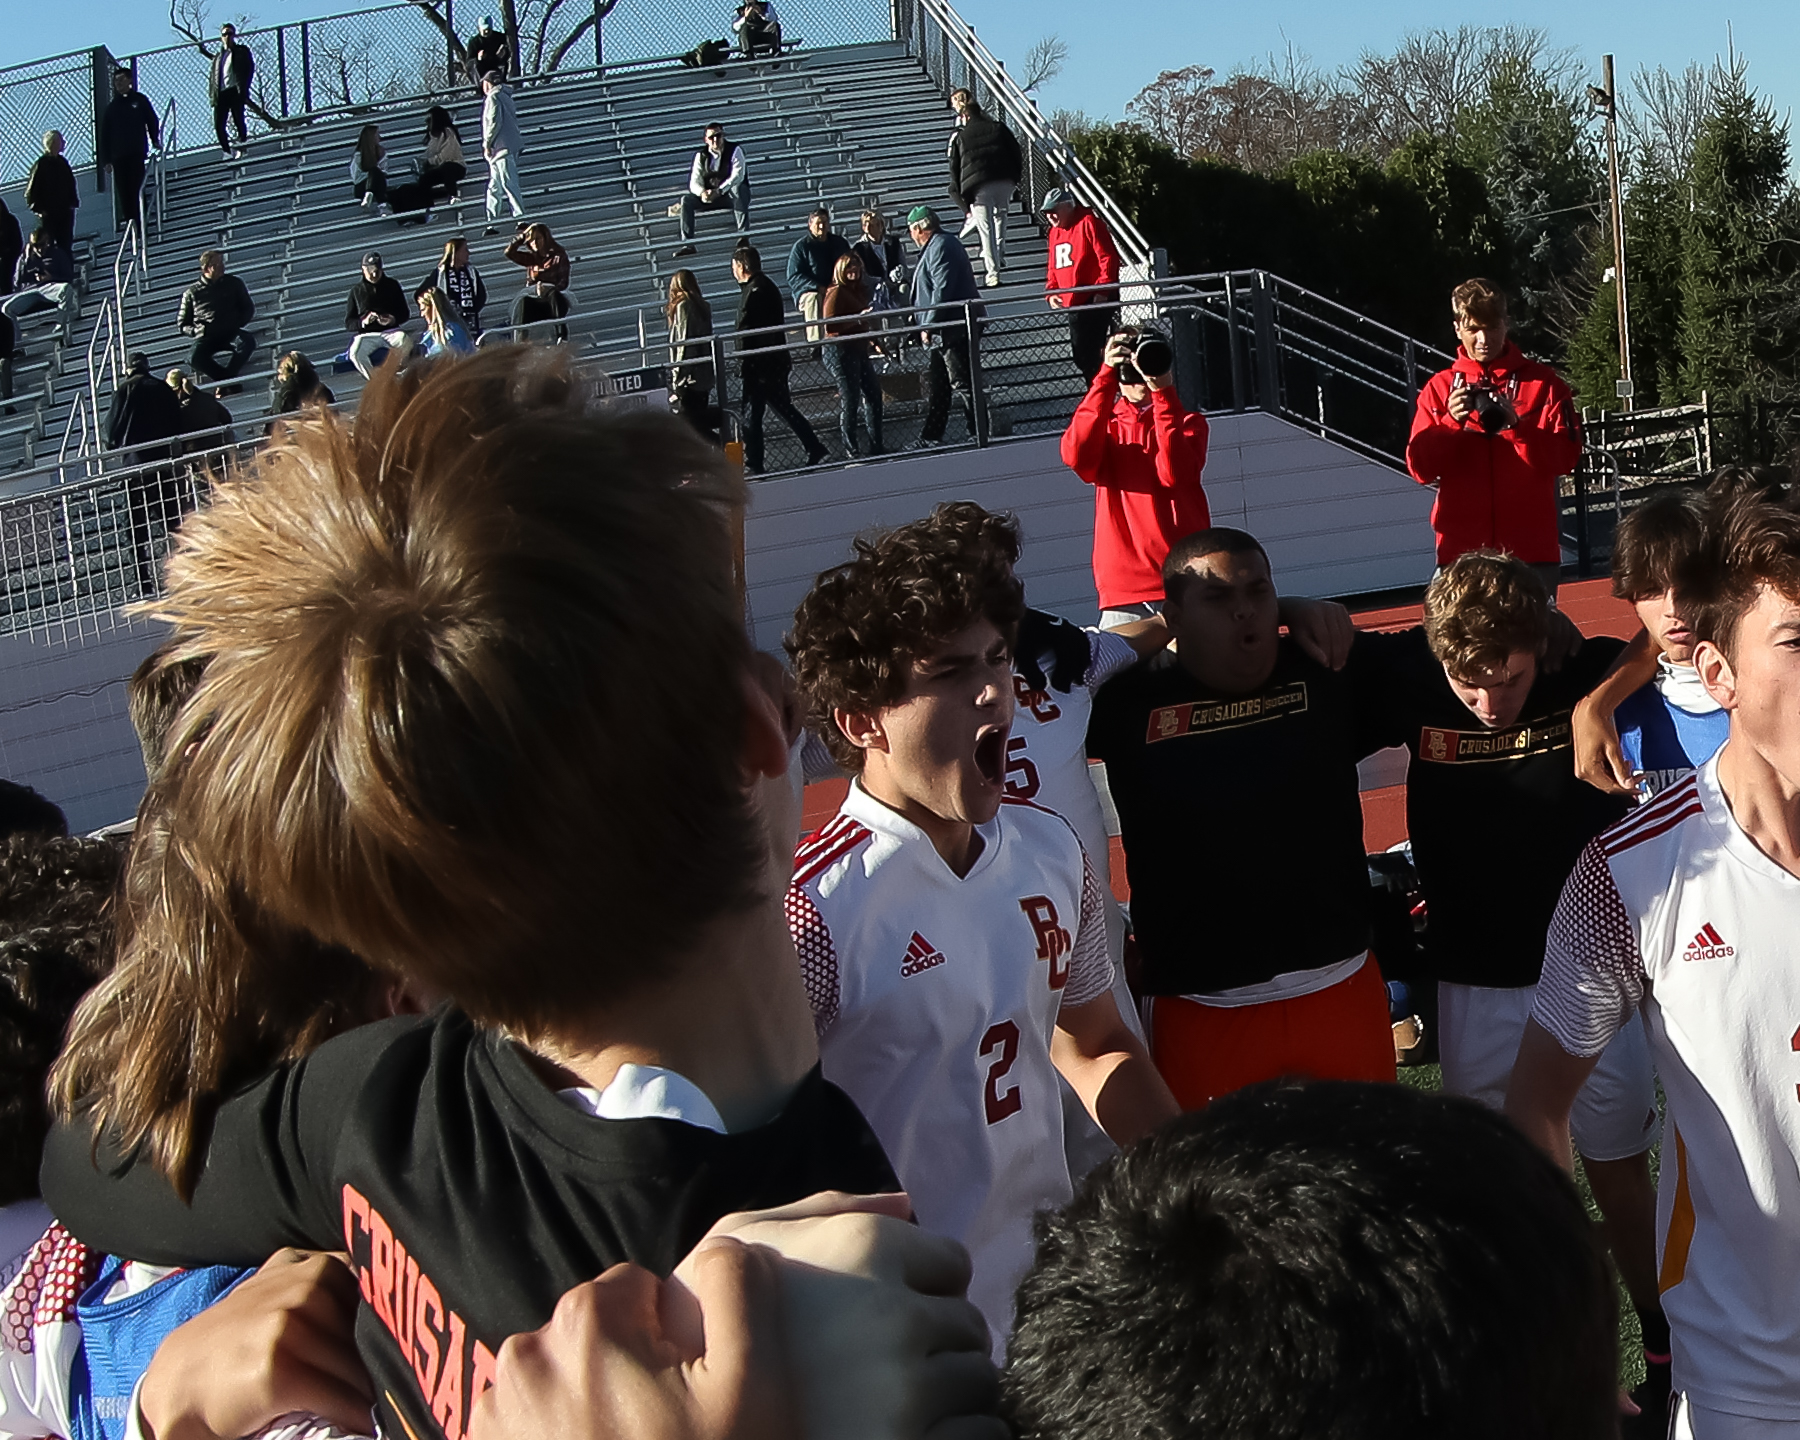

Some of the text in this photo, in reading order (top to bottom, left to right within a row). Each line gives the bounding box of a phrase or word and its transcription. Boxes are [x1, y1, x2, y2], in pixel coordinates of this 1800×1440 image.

[1055, 243, 1073, 269] R
[1192, 699, 1261, 725] CRUSADERS
[1265, 692, 1303, 710] SOCCER
[1459, 730, 1526, 754] CRUSADERS
[1530, 723, 1569, 743] SOCCER
[900, 951, 946, 978] adidas
[1683, 944, 1735, 962] adidas
[978, 1018, 1022, 1125] 2
